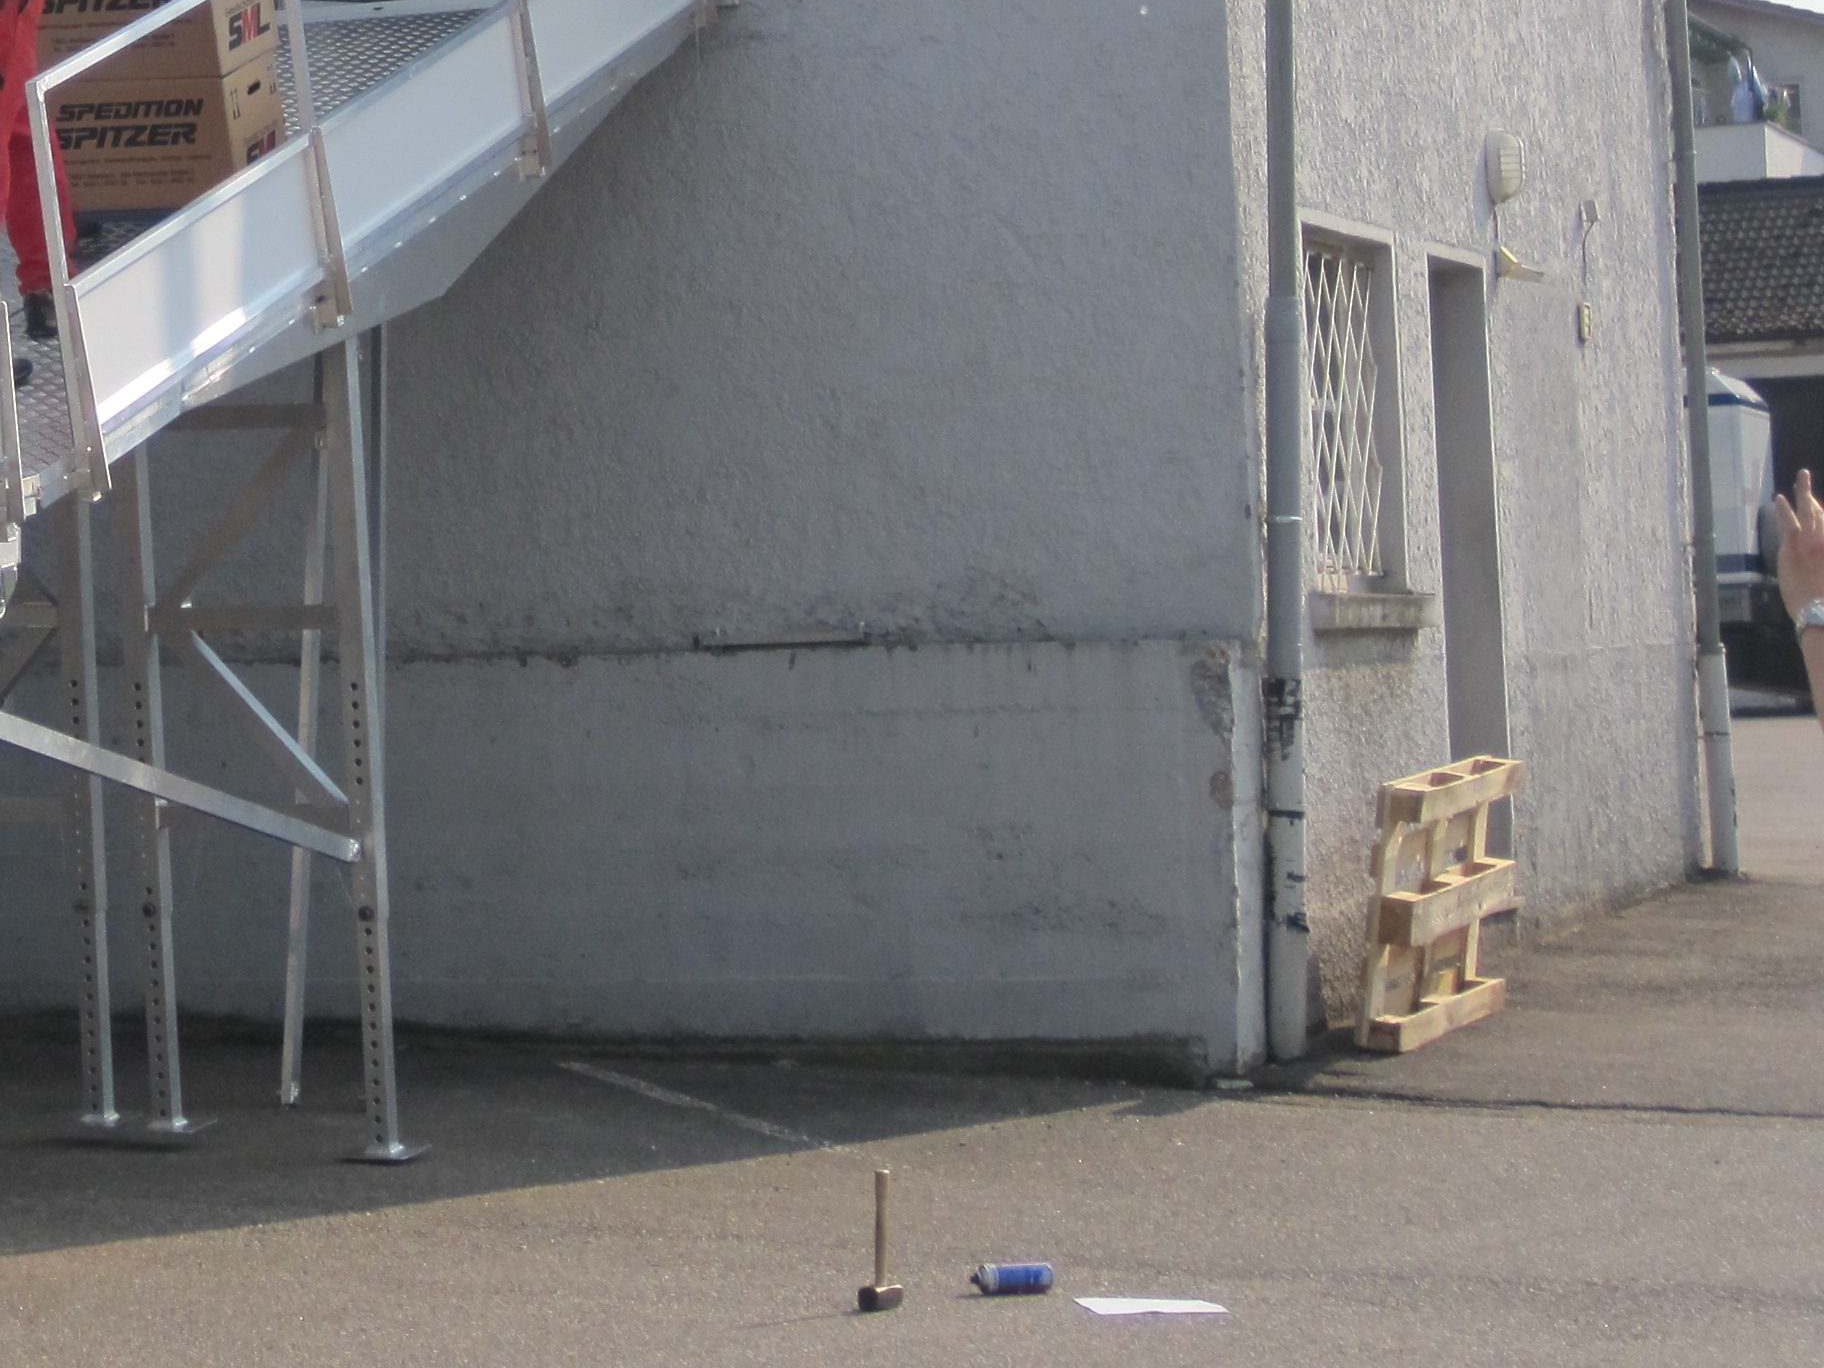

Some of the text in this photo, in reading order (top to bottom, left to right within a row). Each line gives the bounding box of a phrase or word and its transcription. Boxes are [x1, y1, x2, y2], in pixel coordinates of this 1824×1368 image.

[228, 2, 271, 51] SML
[56, 98, 204, 122] SPEDITION
[56, 122, 197, 150] SPITZER
